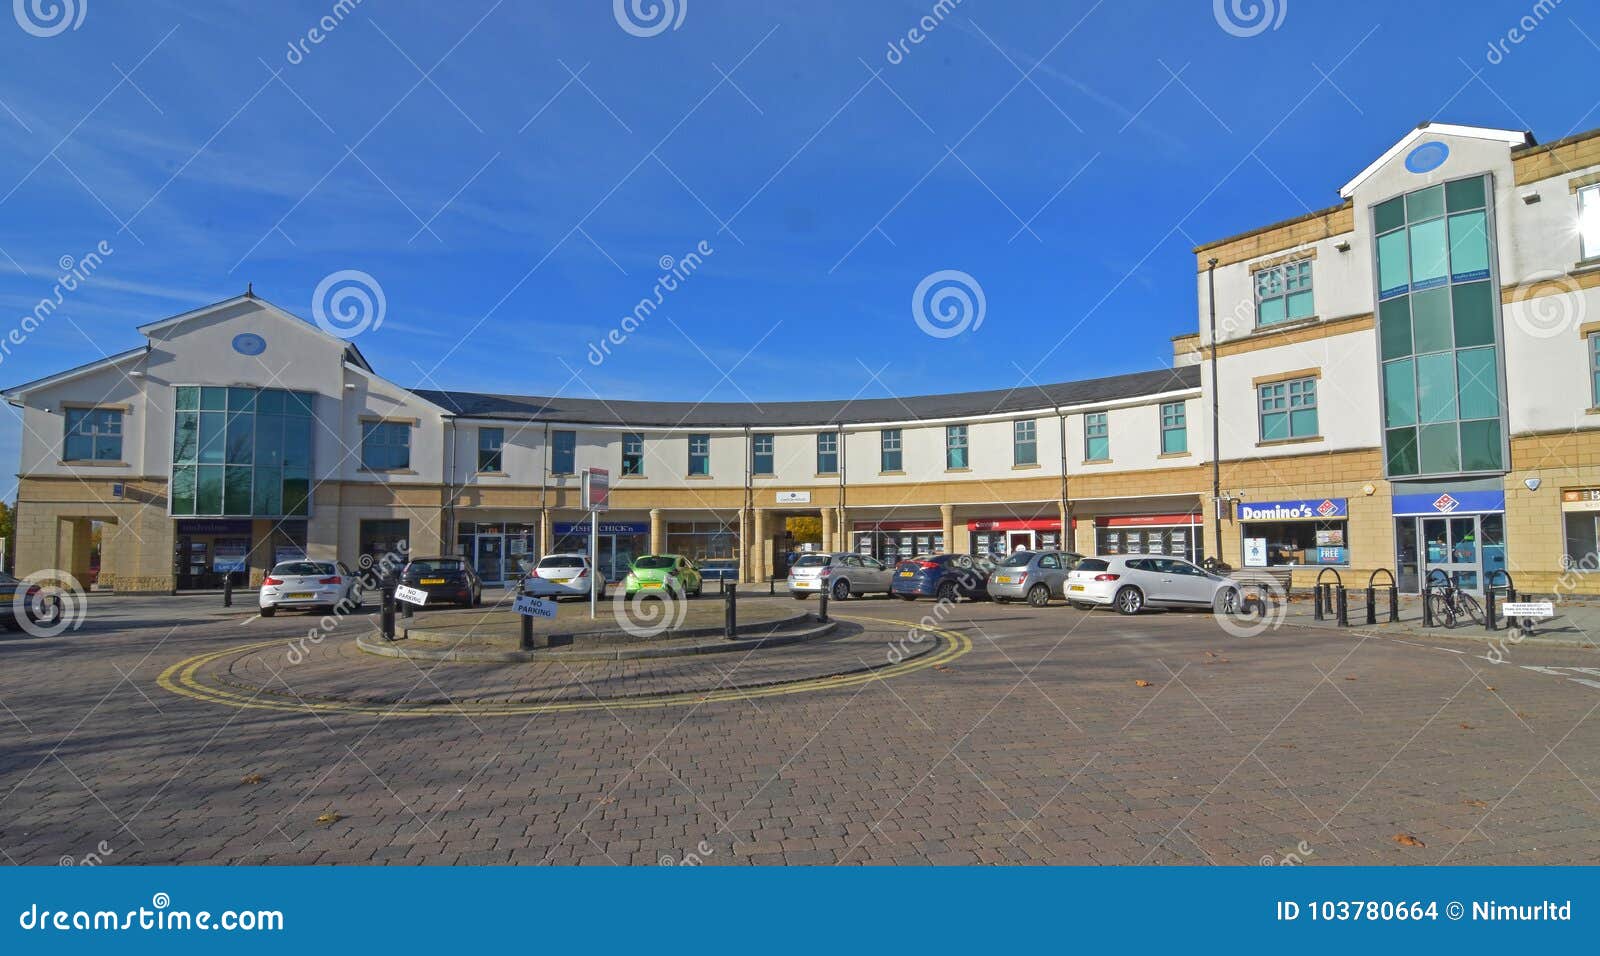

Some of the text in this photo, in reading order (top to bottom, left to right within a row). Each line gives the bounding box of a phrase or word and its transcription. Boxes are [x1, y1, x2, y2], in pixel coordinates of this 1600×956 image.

[1243, 504, 1313, 520] Domino's
[1320, 547, 1339, 558] FREE
[398, 593, 422, 604] PARKING
[407, 589, 417, 597] NO
[530, 599, 543, 607] NO
[518, 605, 551, 617] PARKING
